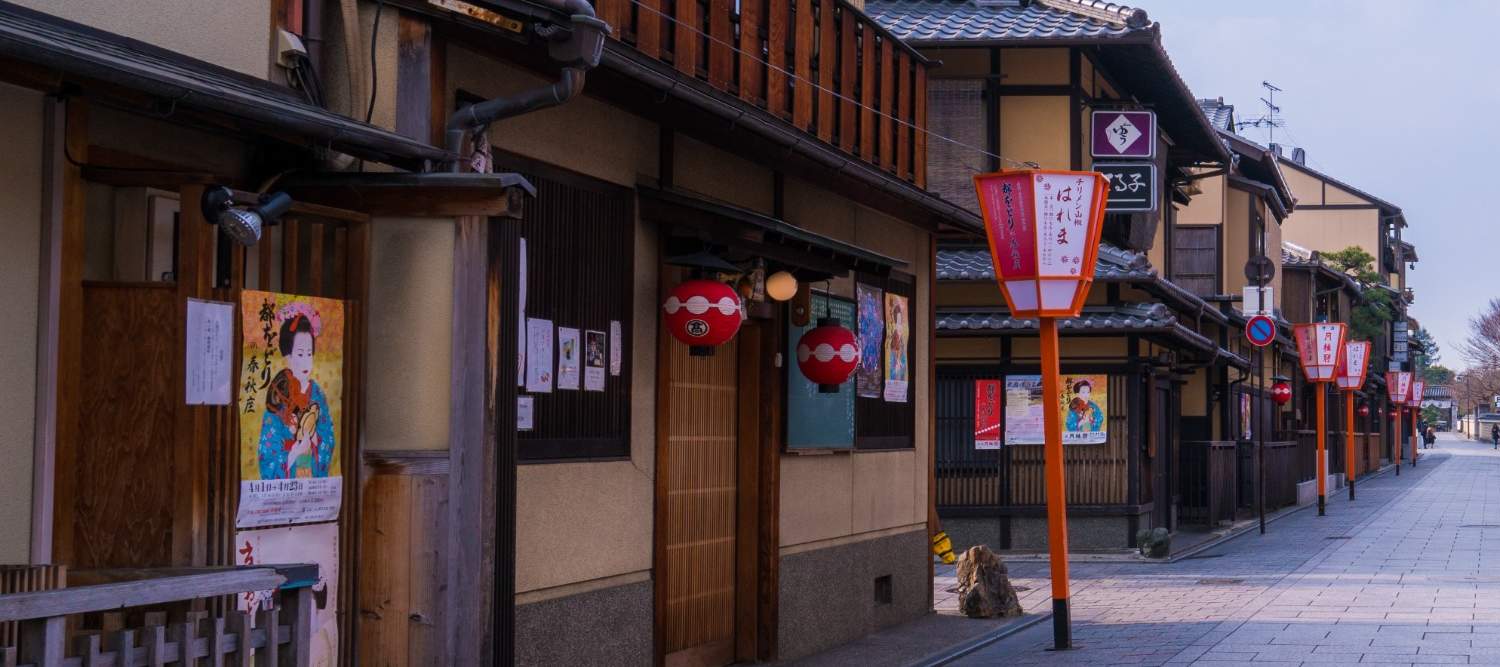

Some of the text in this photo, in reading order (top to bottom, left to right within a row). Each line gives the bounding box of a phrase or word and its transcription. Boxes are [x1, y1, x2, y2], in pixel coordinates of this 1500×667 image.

[1056, 185, 1072, 245] はれま
[259, 298, 277, 390] 都をどり
[244, 356, 259, 413] 春秋座
